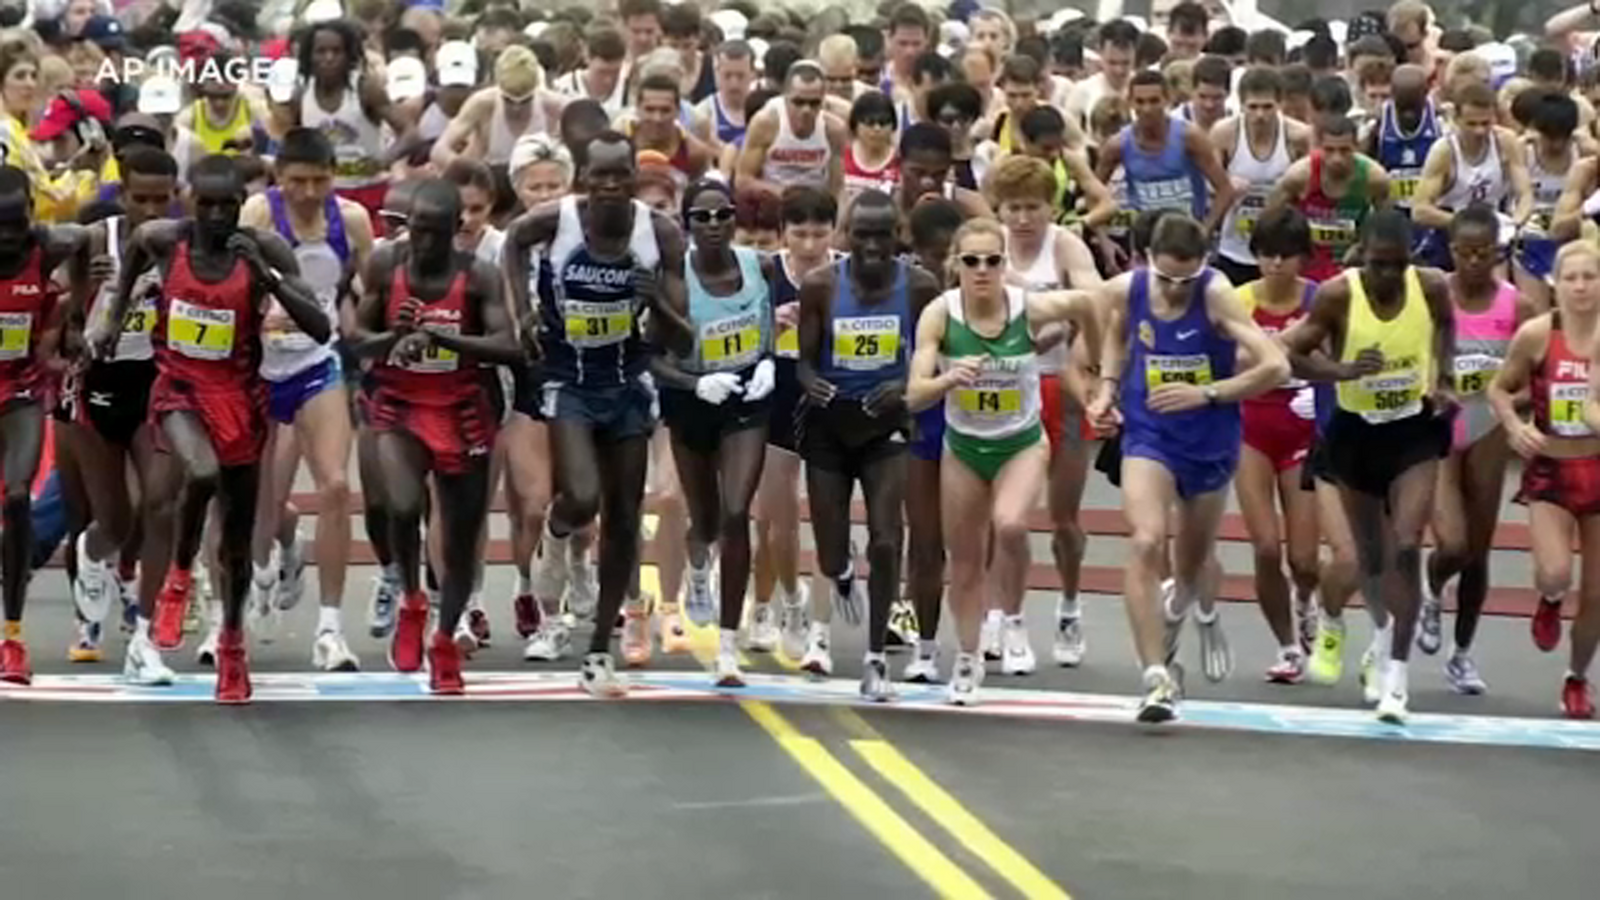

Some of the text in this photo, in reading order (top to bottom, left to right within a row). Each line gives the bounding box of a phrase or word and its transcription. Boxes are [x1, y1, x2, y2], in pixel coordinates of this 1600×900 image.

[564, 264, 632, 286] SAUCON
[195, 322, 208, 345] 7
[586, 317, 609, 337] 31
[724, 332, 742, 356] F1
[855, 334, 880, 356] 25
[1556, 361, 1589, 380] FIL
[978, 391, 1000, 412] F4
